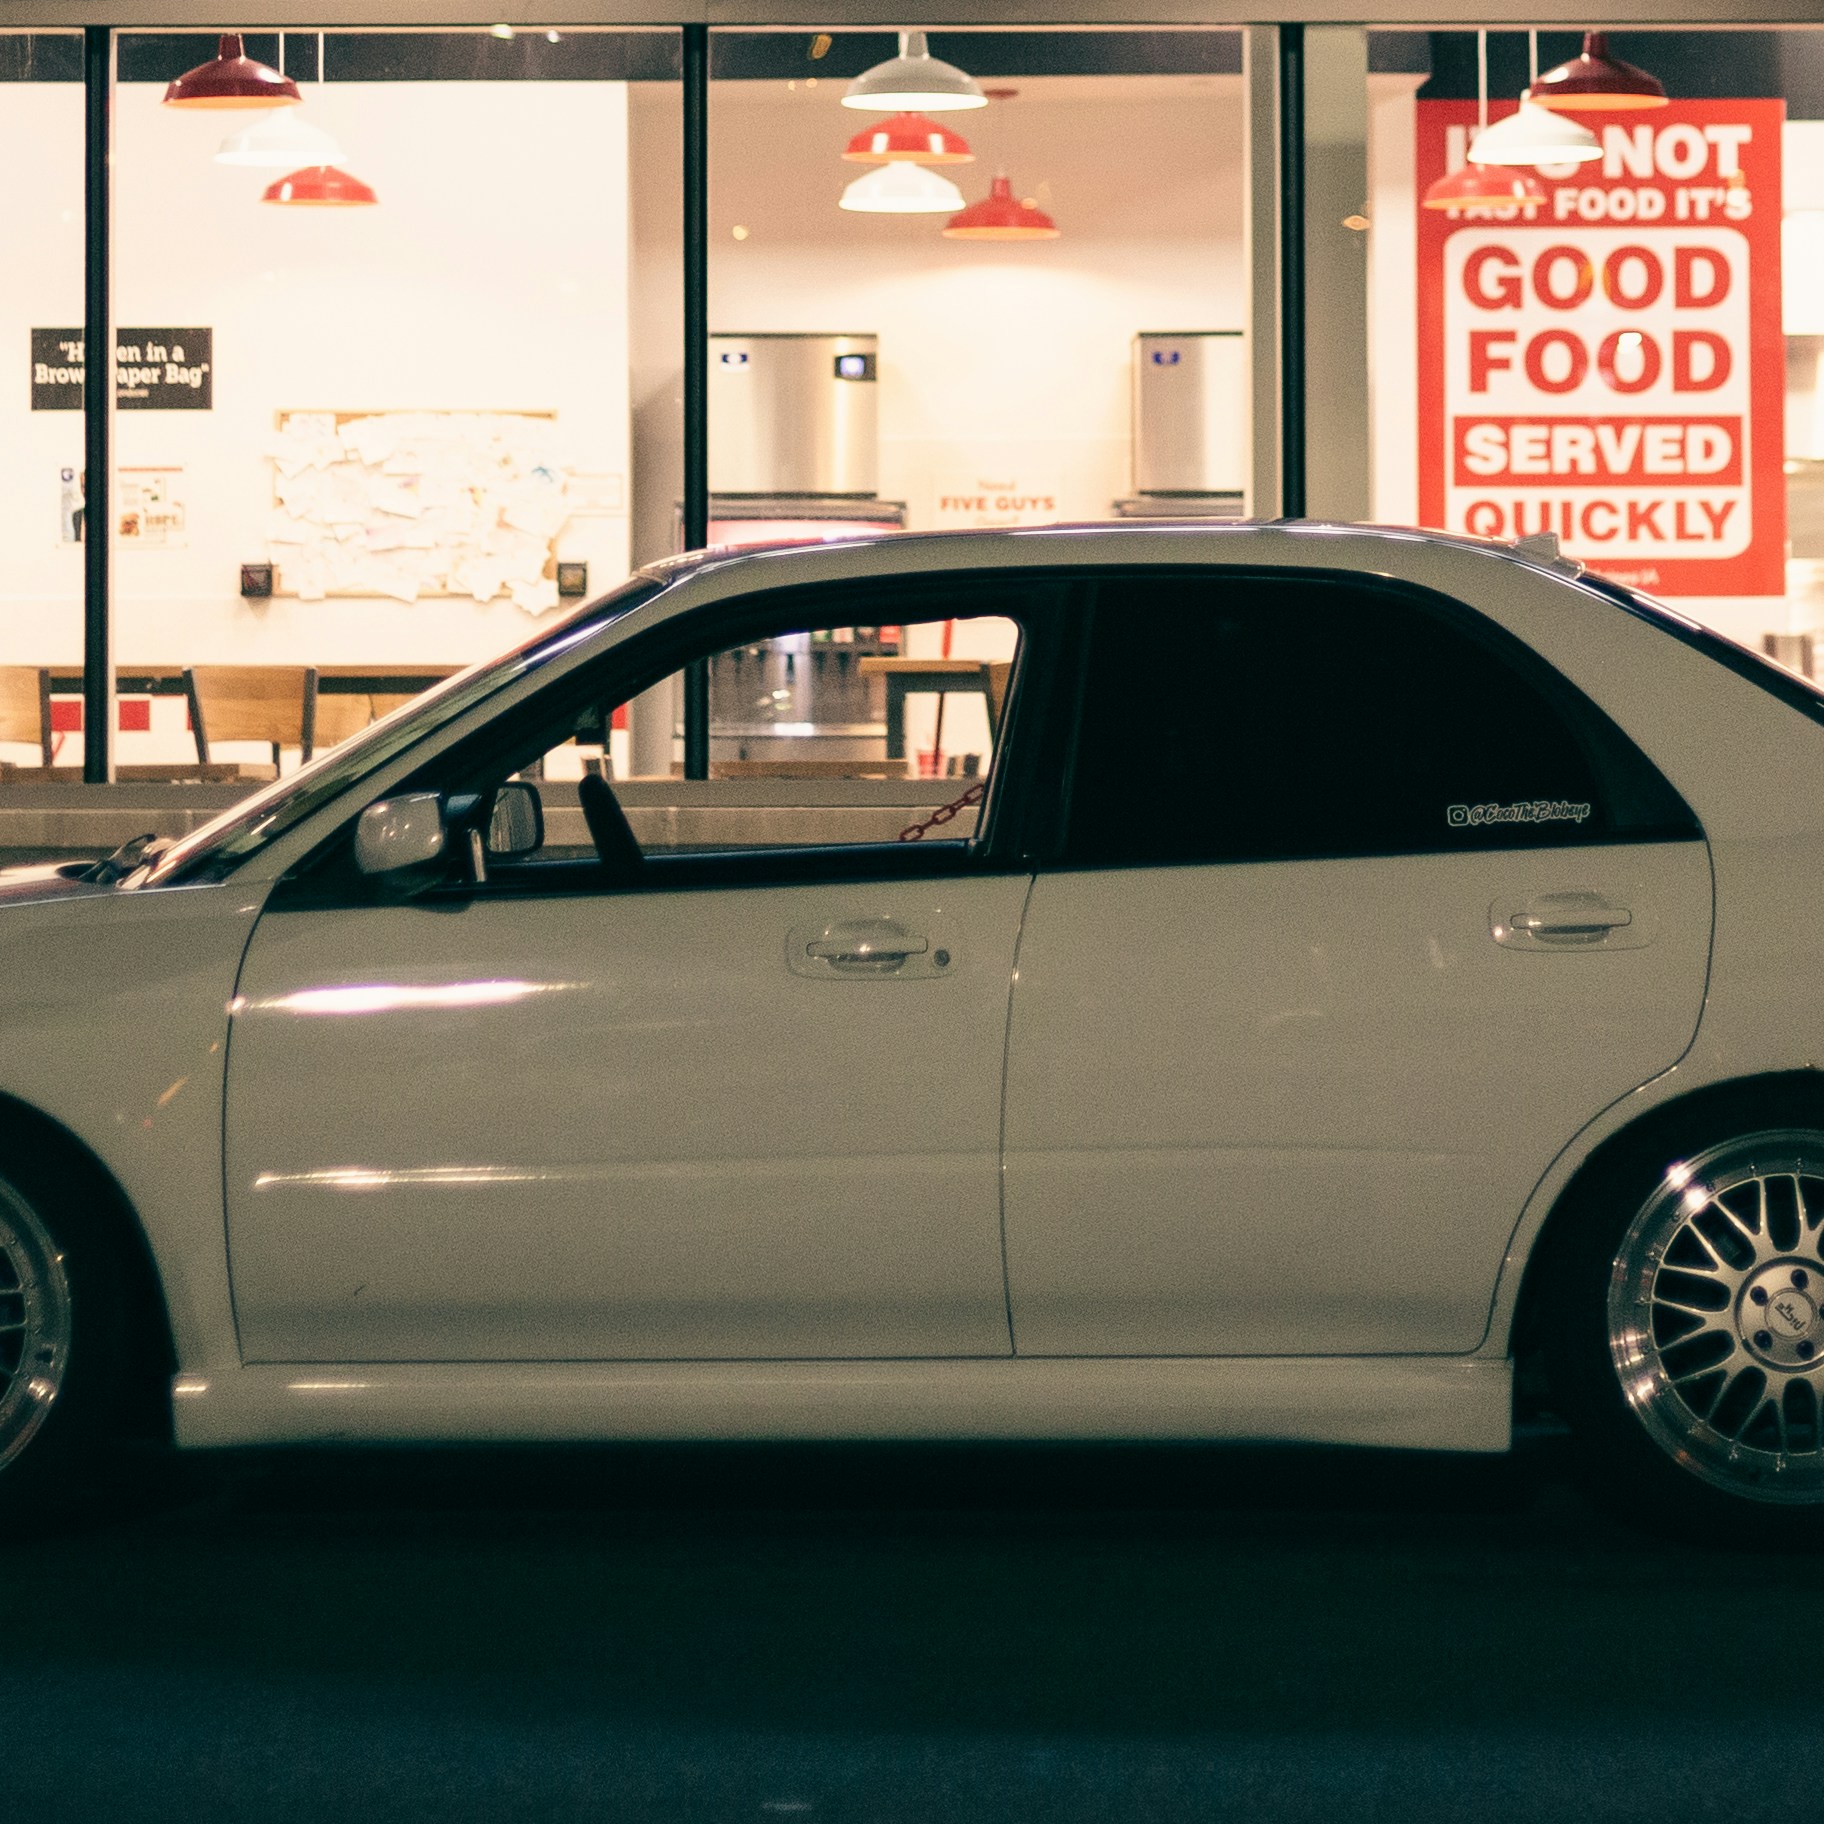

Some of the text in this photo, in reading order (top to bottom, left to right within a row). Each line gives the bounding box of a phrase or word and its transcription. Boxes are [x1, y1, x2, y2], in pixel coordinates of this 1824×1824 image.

[1602, 123, 1753, 179] NOT
[1554, 187, 1667, 220] FOOD
[1675, 187, 1753, 220] IT'S
[1462, 245, 1734, 310] GOOD
[146, 341, 168, 362] in
[172, 345, 185, 362] a
[1468, 329, 1734, 394] FOOD
[35, 362, 86, 384] Brow
[116, 366, 162, 388] aper
[1464, 423, 1733, 475] SERVED
[940, 496, 1056, 511] FIVE GUYS
[1465, 500, 1736, 542] QUICKLY
